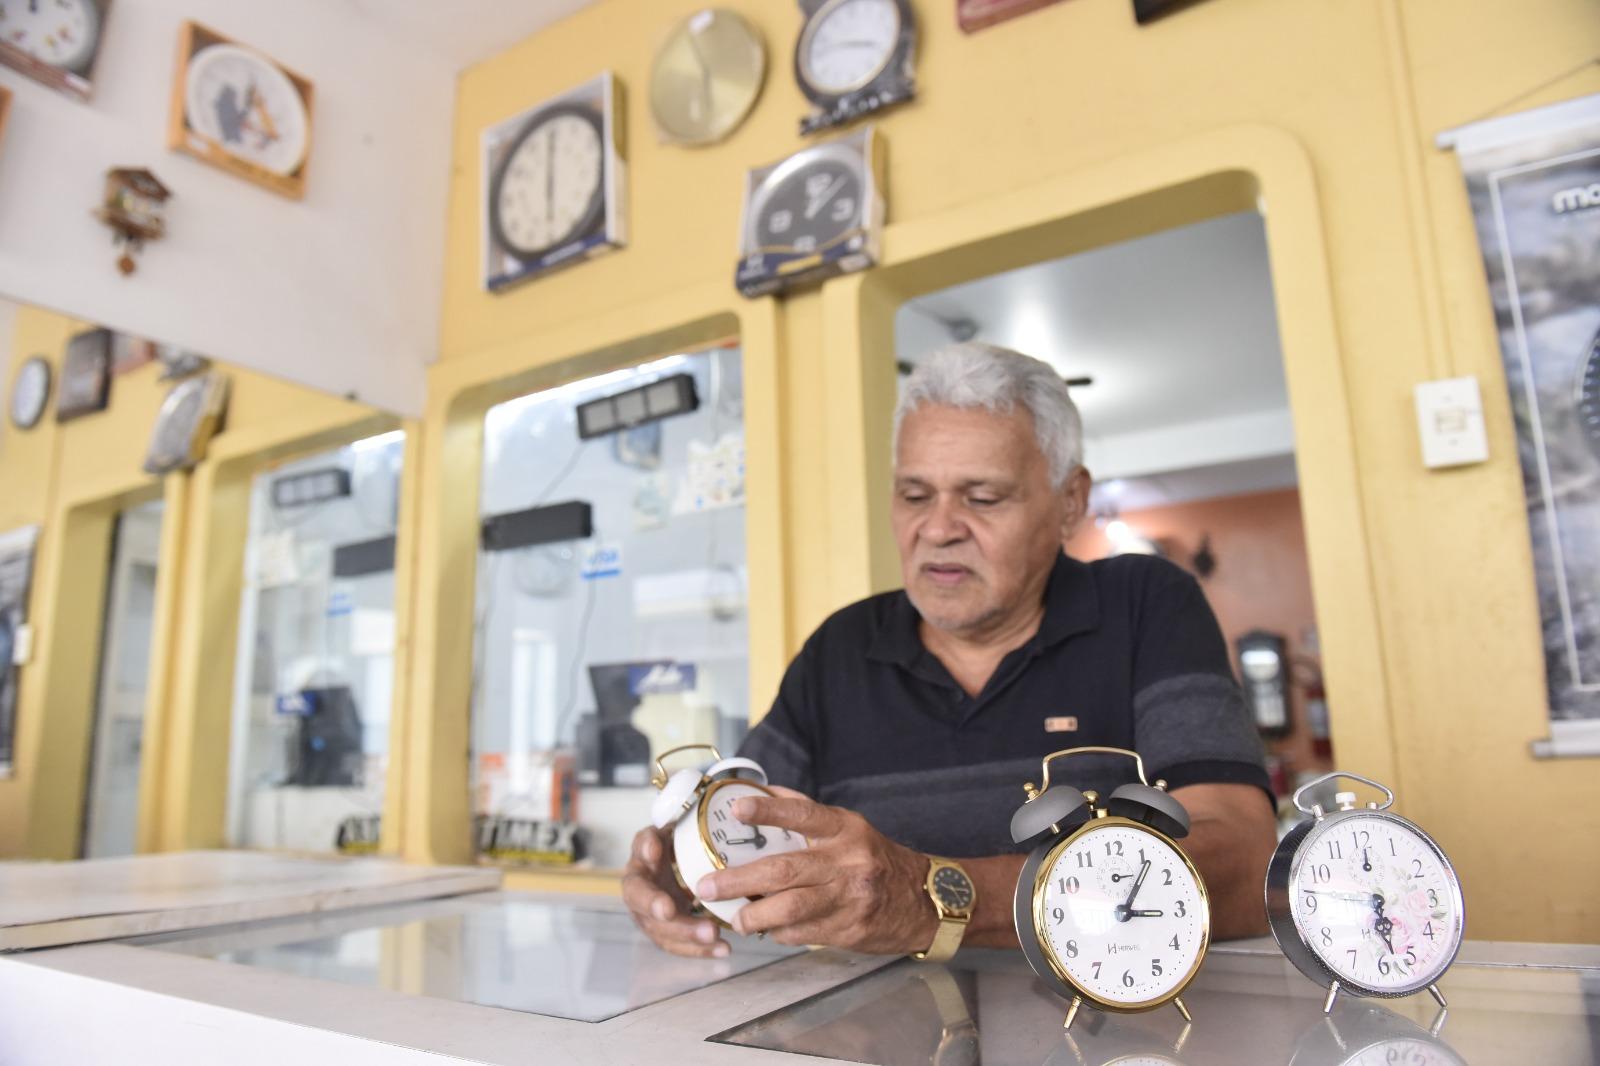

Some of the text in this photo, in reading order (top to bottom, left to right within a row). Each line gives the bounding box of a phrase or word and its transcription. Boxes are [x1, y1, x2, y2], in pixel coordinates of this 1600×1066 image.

[711, 828, 728, 843] 10
[1352, 831, 1372, 849] 12
[1105, 841, 1124, 857] 12
[1138, 848, 1147, 864] 1
[1327, 840, 1343, 860] 11
[1389, 838, 1398, 857] 1
[1076, 850, 1093, 868] 11
[1162, 868, 1173, 886] 2
[1309, 864, 1331, 884] 10
[1411, 859, 1425, 879] 2
[1059, 876, 1080, 894] 10
[1306, 895, 1317, 915] 9
[1427, 888, 1439, 909] 3
[1053, 908, 1065, 925] 9
[1174, 900, 1186, 918] 3
[1322, 927, 1333, 947] 8
[1423, 921, 1434, 941] 4
[1066, 940, 1078, 958] 8
[1168, 933, 1180, 951] 4
[1346, 950, 1357, 969] 7
[1406, 945, 1417, 966] 5
[1092, 962, 1102, 979] 7
[1151, 959, 1163, 977] 5
[1378, 956, 1390, 976] 6
[1122, 969, 1135, 987] 6
